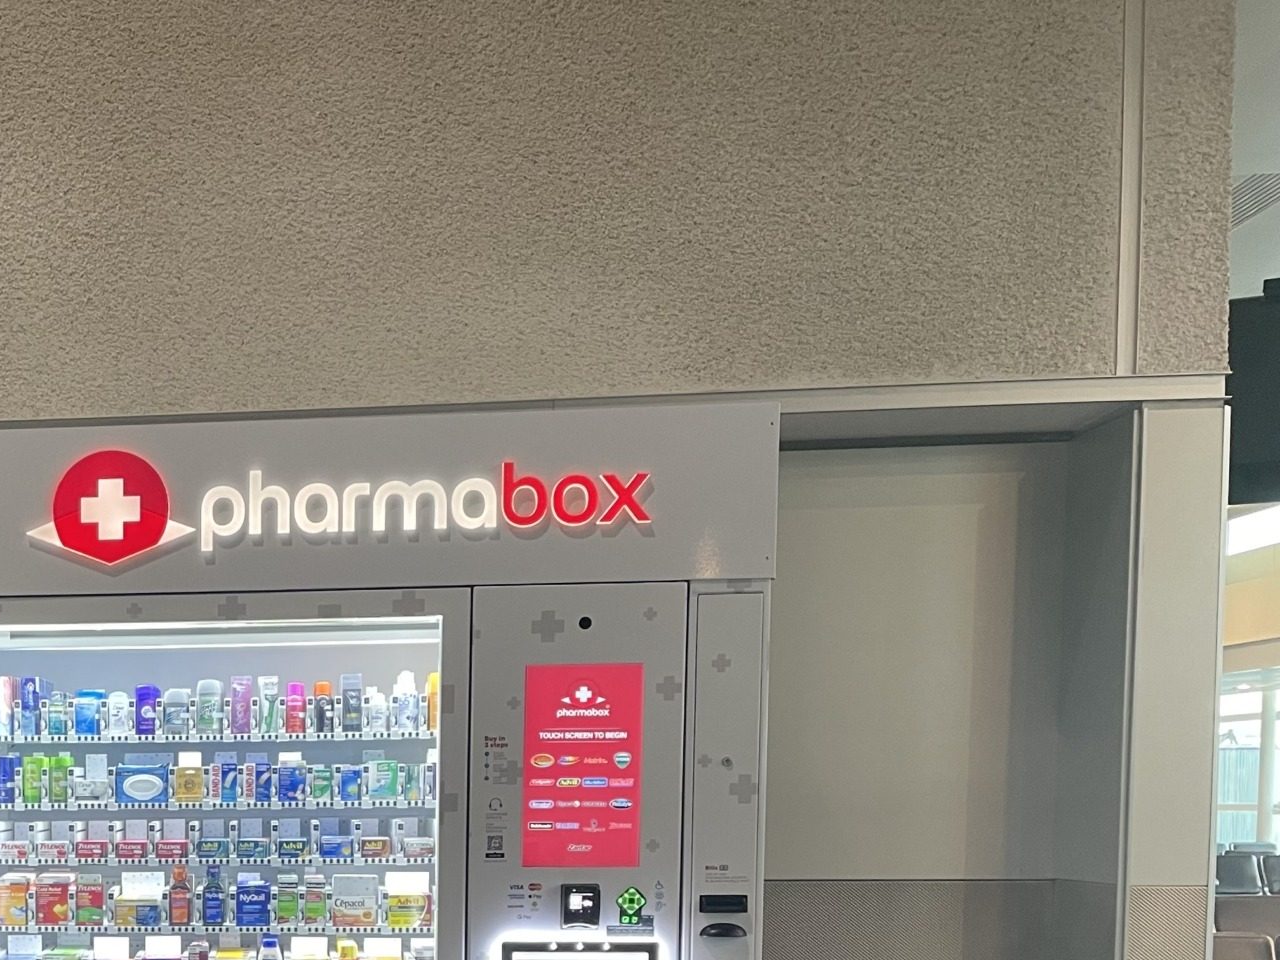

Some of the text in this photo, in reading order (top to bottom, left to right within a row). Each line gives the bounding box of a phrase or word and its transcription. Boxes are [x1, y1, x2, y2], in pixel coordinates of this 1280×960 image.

[200, 461, 652, 552] pharmabox
[556, 706, 610, 718] pharmabox
[539, 731, 627, 740] TOUCH SCREEN TO BEGIN
[212, 765, 220, 798] BAND-AID
[246, 765, 254, 798] BAND-AID
[240, 894, 265, 903] NyQuil
